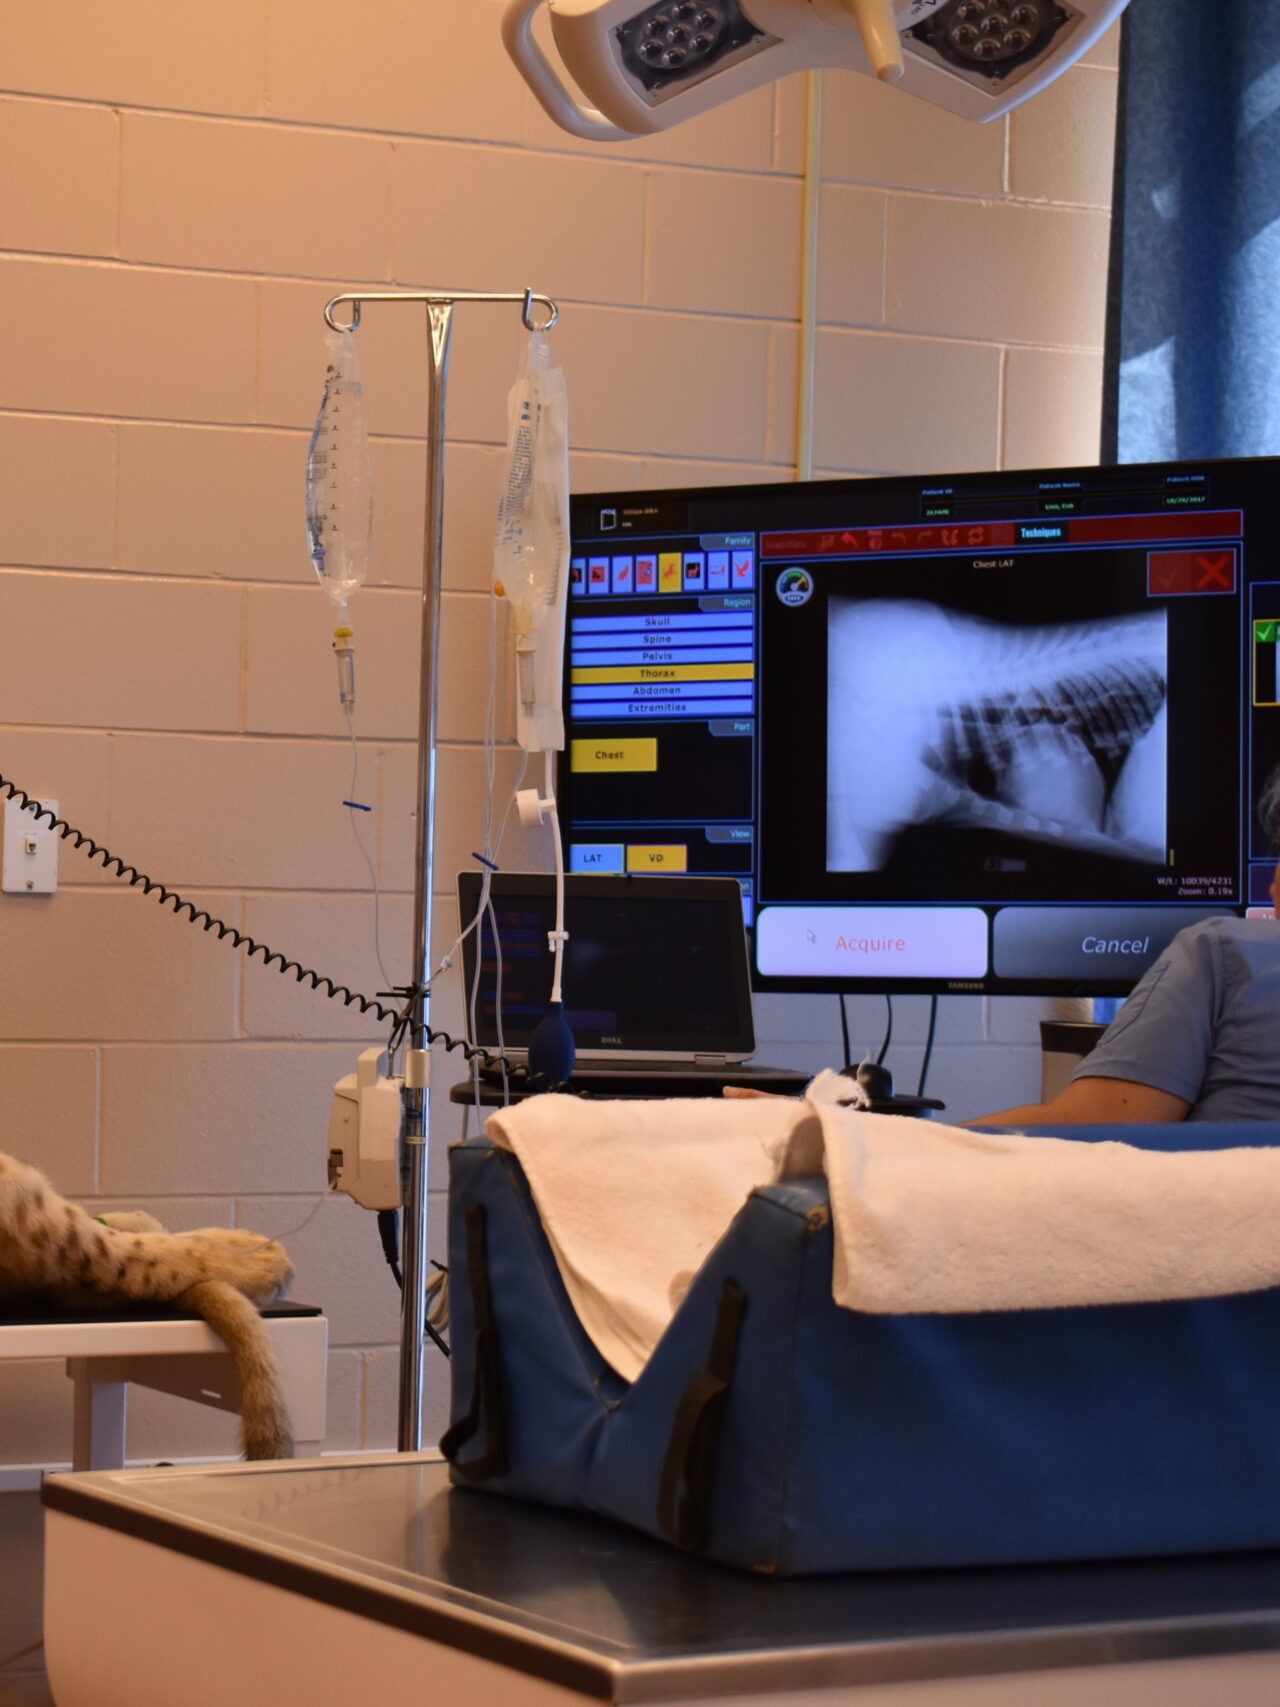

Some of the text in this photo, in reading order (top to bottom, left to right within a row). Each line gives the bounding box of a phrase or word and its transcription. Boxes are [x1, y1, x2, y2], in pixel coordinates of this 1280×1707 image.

[1020, 527, 1062, 538] Techniques
[724, 536, 751, 546] Family
[972, 559, 1015, 569] Chest LAT
[723, 598, 751, 608] Region
[645, 618, 670, 626] Skull
[643, 635, 672, 645] Spine
[642, 652, 673, 661] Pelvis
[640, 669, 676, 678] Thorax
[633, 686, 681, 695] Abdomen
[628, 704, 687, 713] Extremities
[734, 722, 751, 731] Part
[595, 751, 624, 760] Chest
[730, 830, 750, 838] View
[583, 854, 602, 863] LAT
[649, 854, 664, 863] VD
[835, 935, 906, 953] Acquire
[1081, 936, 1150, 954] Cancel
